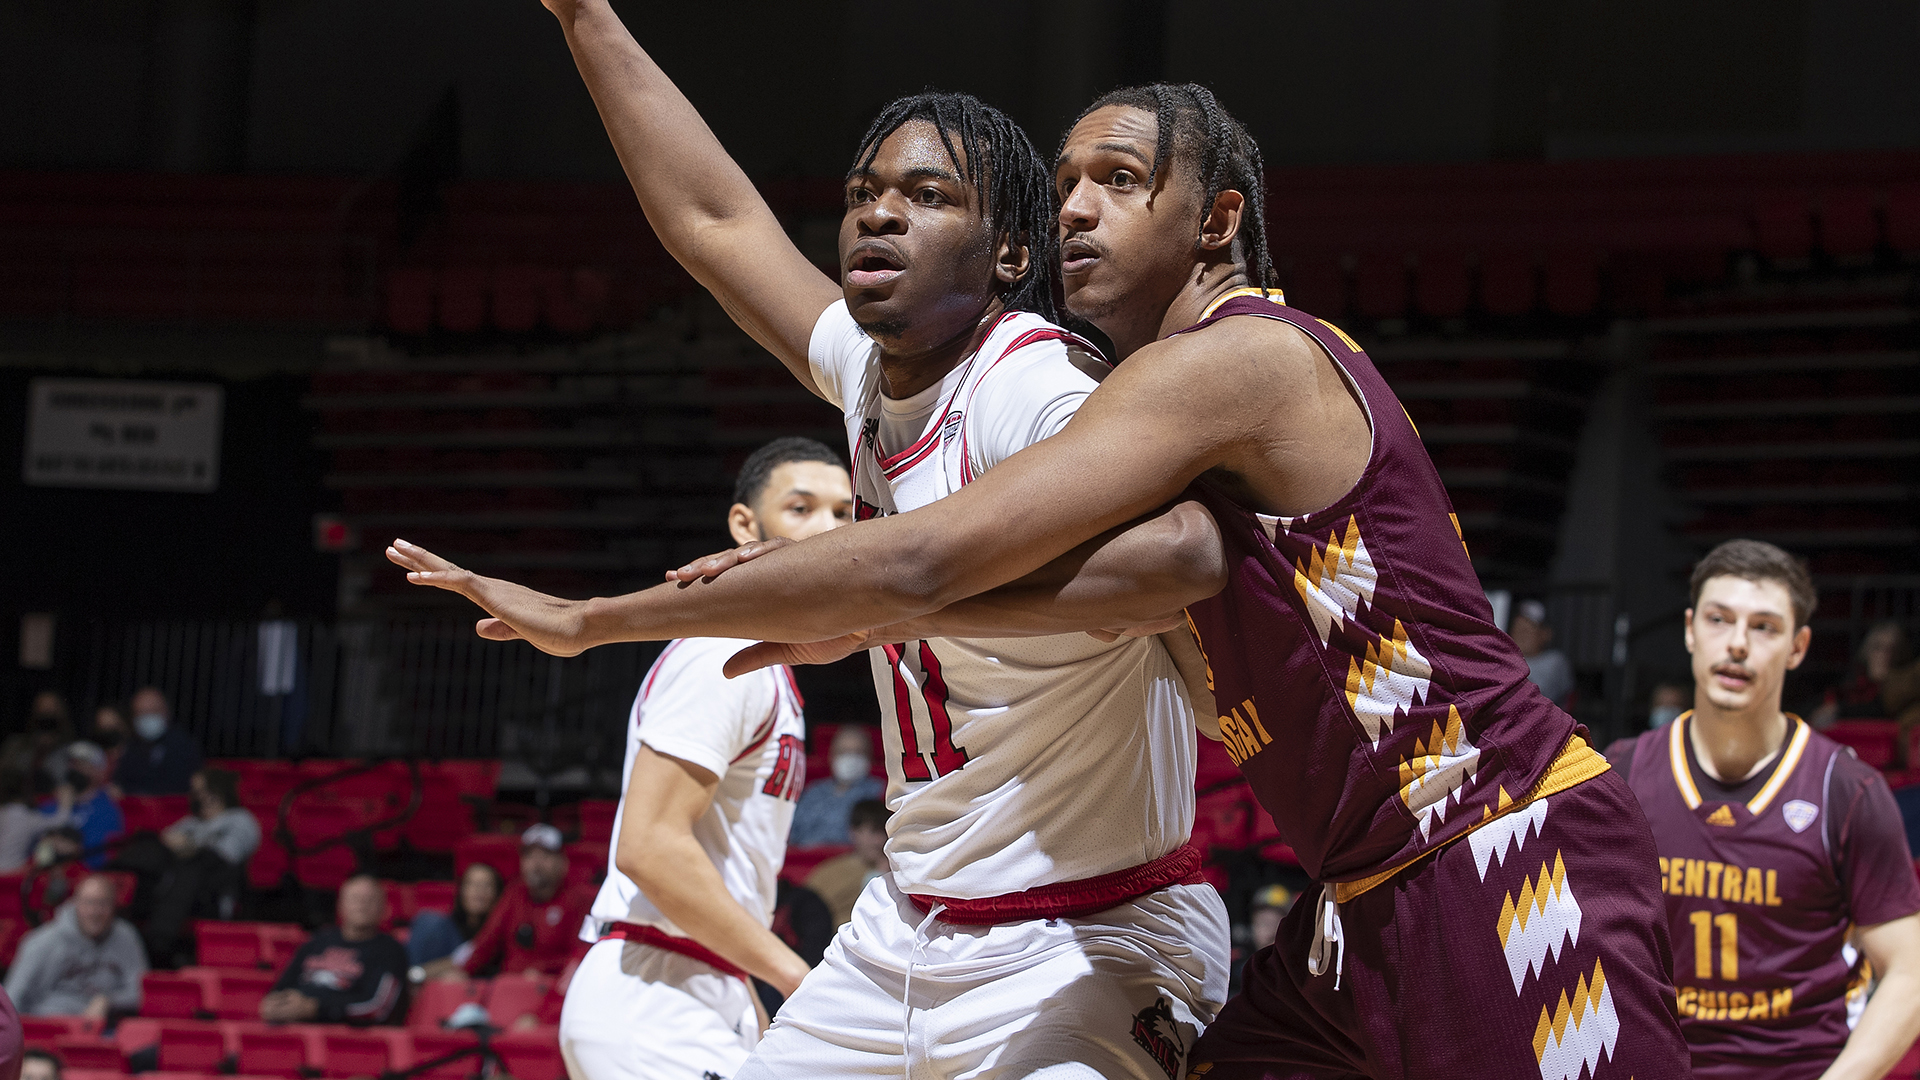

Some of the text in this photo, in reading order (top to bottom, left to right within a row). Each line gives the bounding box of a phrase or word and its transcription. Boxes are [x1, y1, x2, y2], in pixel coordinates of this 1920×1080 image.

[882, 639, 969, 782] 11
[1658, 857, 1782, 906] CENTRAL
[1689, 911, 1739, 981] 11
[1675, 986, 1794, 1021] CHIGAN
